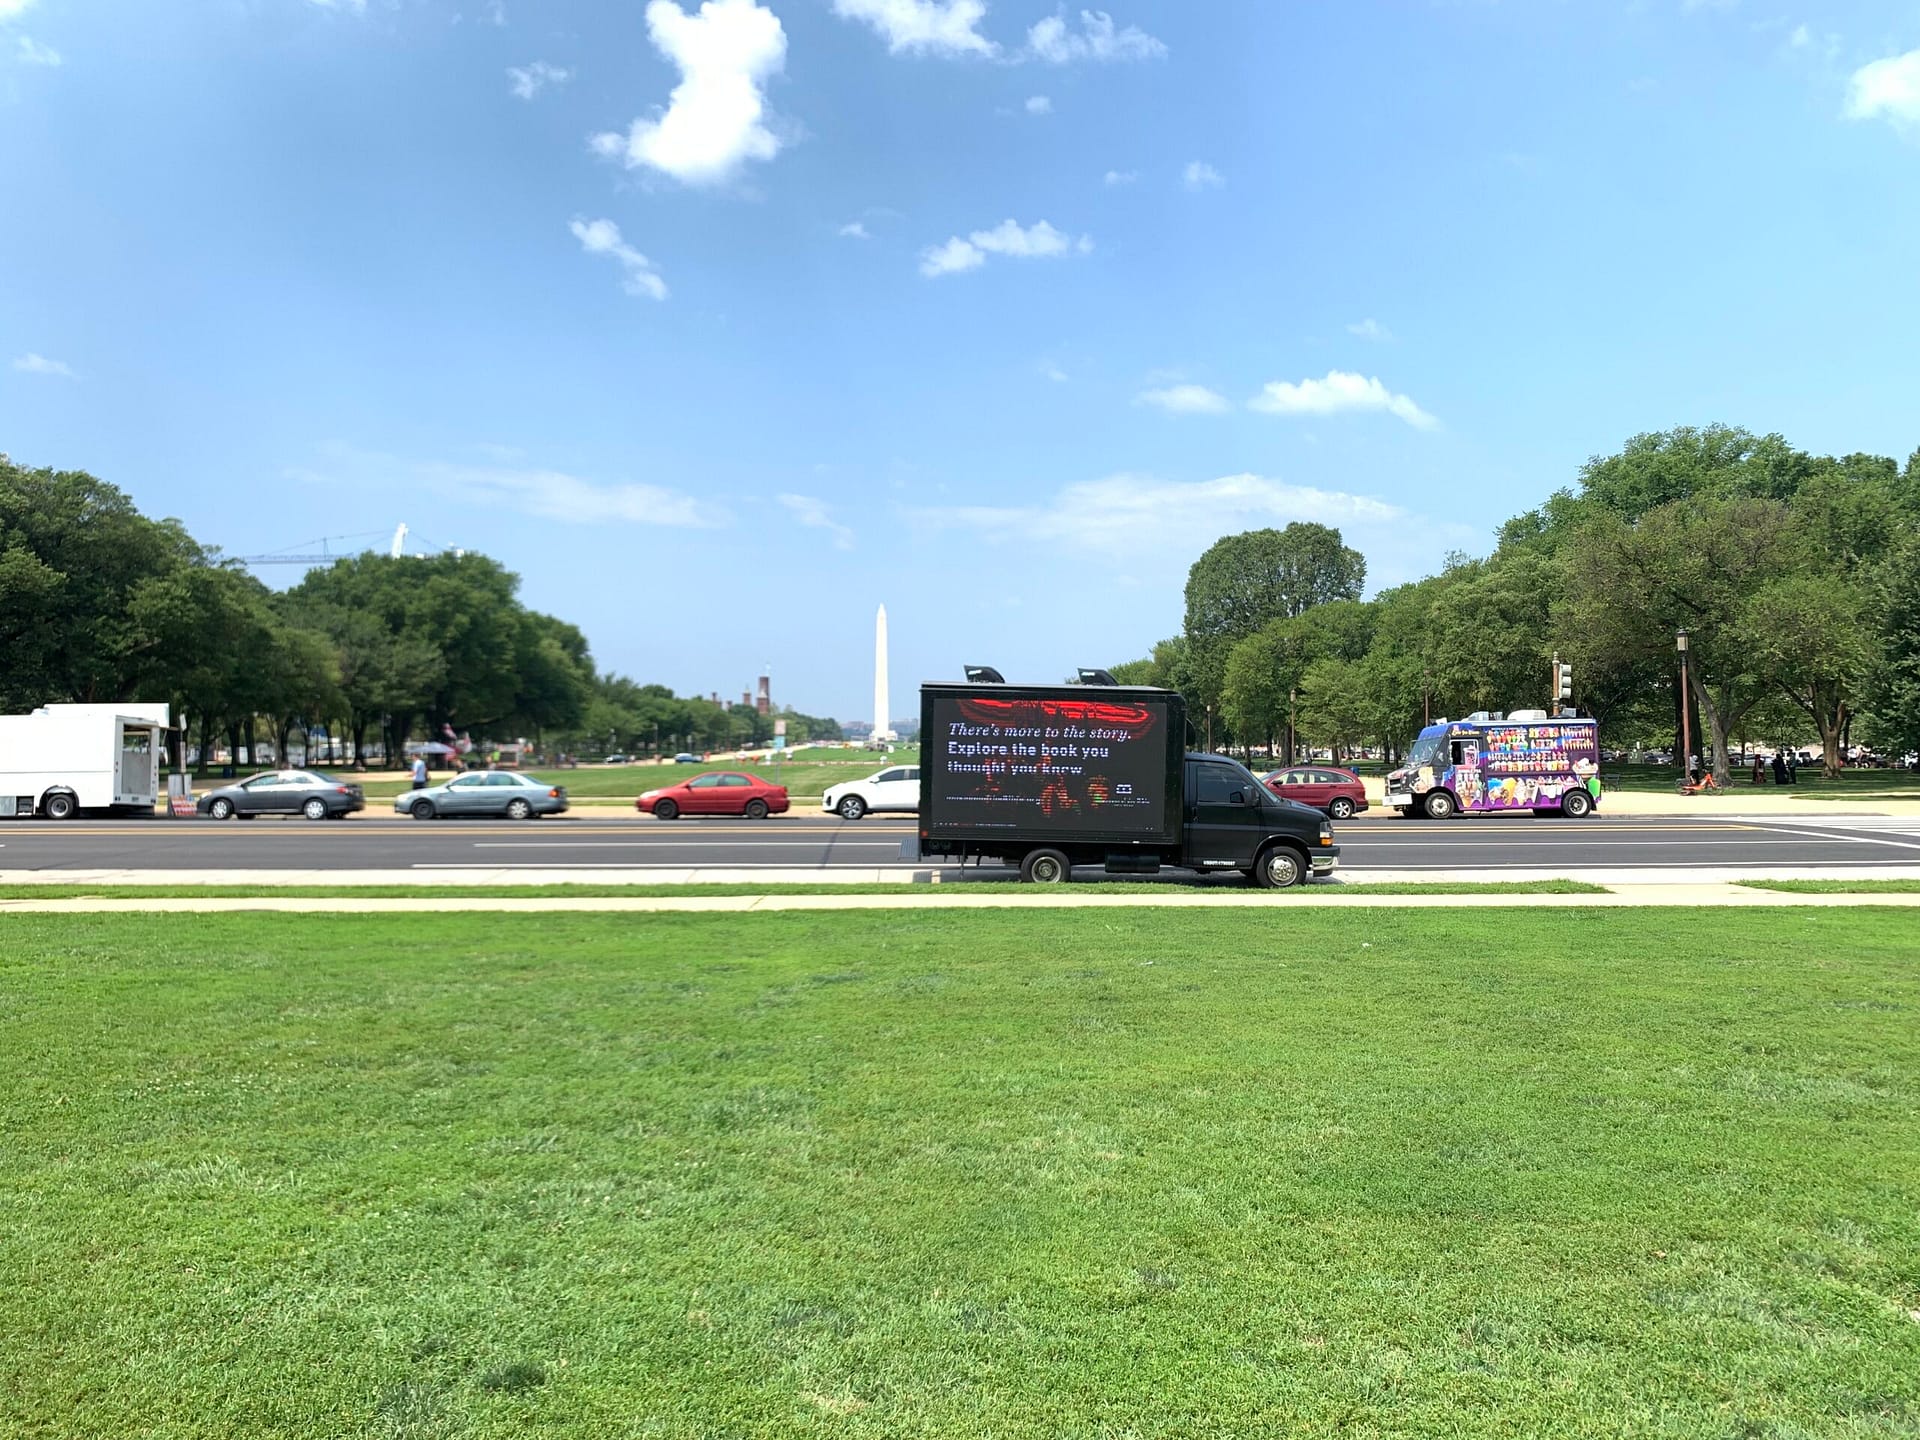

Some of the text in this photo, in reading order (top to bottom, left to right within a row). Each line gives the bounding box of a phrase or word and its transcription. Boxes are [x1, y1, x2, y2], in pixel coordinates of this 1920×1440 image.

[949, 722, 1132, 743] There's more to the story.
[948, 741, 1109, 760] Explore the book you
[947, 760, 1006, 775] thought
[1010, 764, 1037, 776] you
